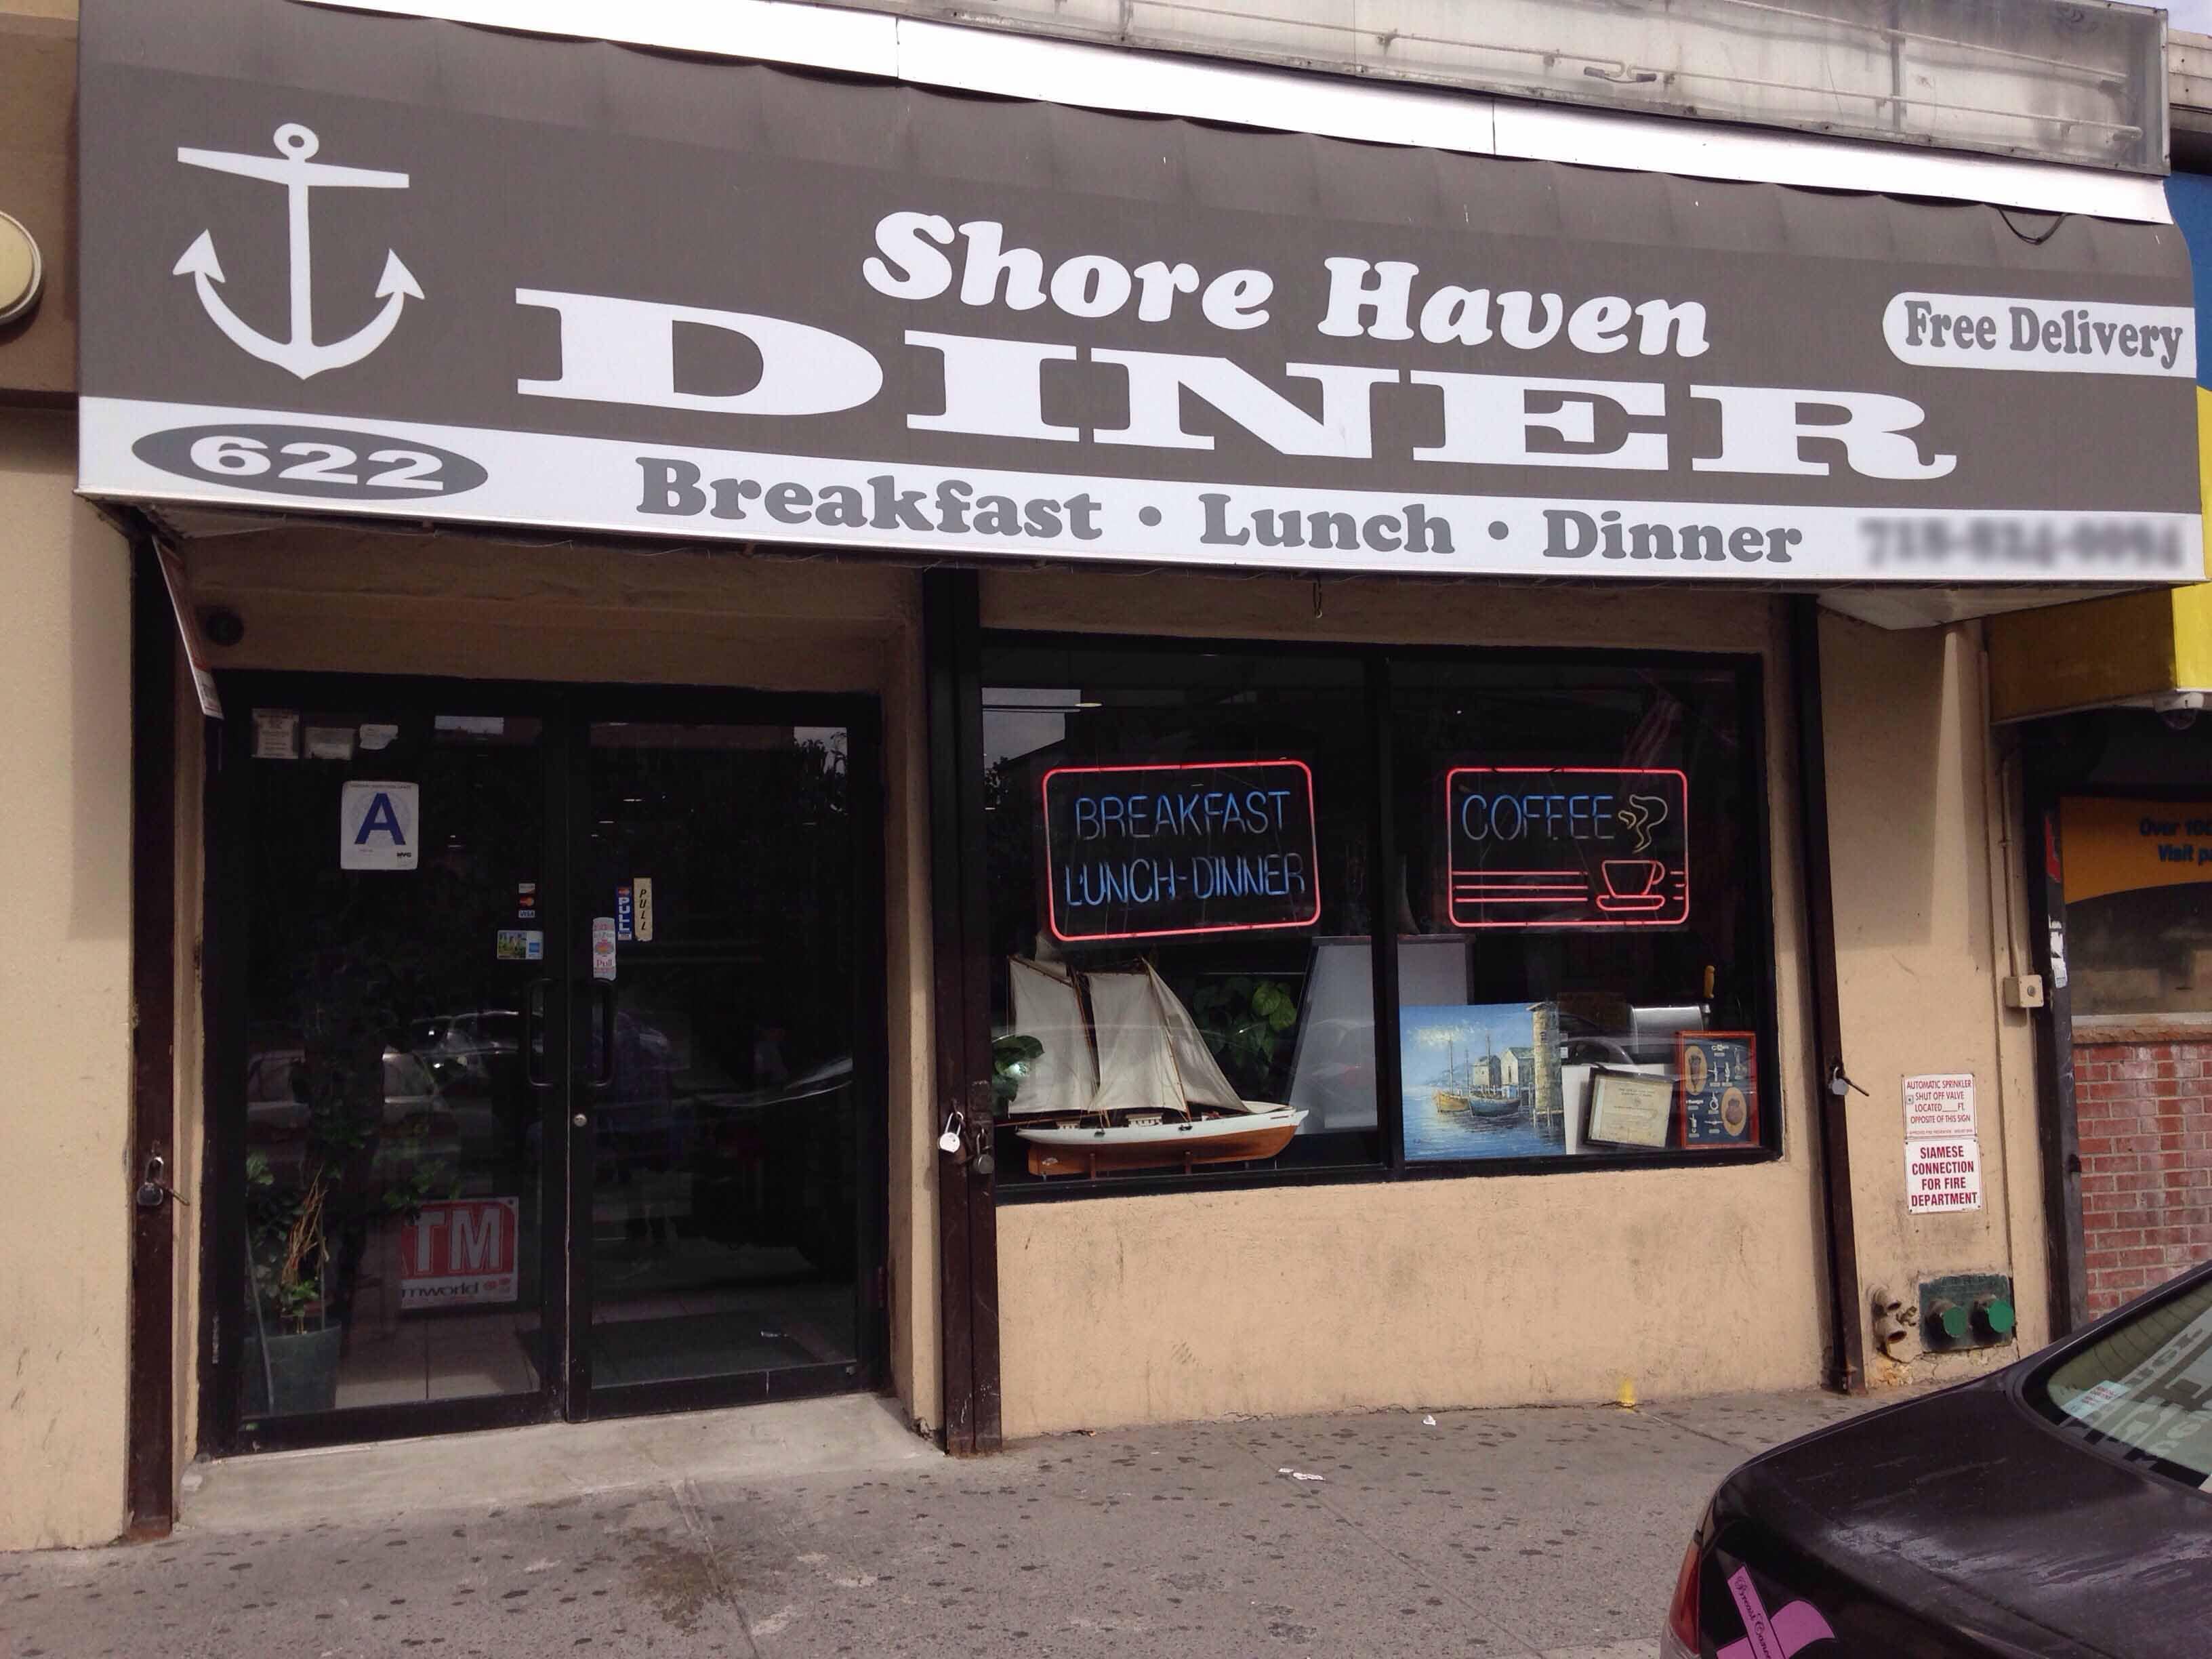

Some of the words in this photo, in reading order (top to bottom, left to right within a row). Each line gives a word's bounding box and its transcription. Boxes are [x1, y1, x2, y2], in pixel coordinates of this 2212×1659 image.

[863, 211, 1274, 330] Shore
[1317, 257, 1710, 357] Haven
[1904, 300, 1996, 351] Free
[2009, 306, 2184, 369] Delivery
[516, 287, 1957, 480] DINER
[190, 435, 444, 491] 622
[635, 456, 1103, 540] Breakfast
[1198, 493, 1456, 554] Lunch
[1542, 509, 1803, 563] Dinner
[354, 793, 405, 845] A
[1075, 791, 1291, 841] BREAKFAST
[1462, 794, 1614, 841] COFFEE
[618, 897, 631, 932] PULL
[639, 889, 647, 931] PULL
[1906, 1080, 1941, 1090] AUTOMATIC
[1942, 1079, 1972, 1089] SPRINKLER
[1915, 1092, 1931, 1101] SHUT
[1933, 1092, 1945, 1101] OFF
[1946, 1091, 1965, 1100] VALVE
[1910, 1115, 1936, 1124] OPPOSITE
[1936, 1115, 1945, 1123] OF
[1945, 1115, 1957, 1123] THIS
[1957, 1114, 1971, 1122] SIGN
[1914, 1103, 1942, 1112] LOCATED
[1912, 1161, 1974, 1175] CONNECTION
[1920, 1145, 1964, 1160] SIAMESE
[1911, 1191, 1978, 1207] DEPARTMENT
[1921, 1178, 1942, 1191] FOR
[1944, 1176, 1966, 1189] FIRE
[402, 1208, 501, 1274] TM
